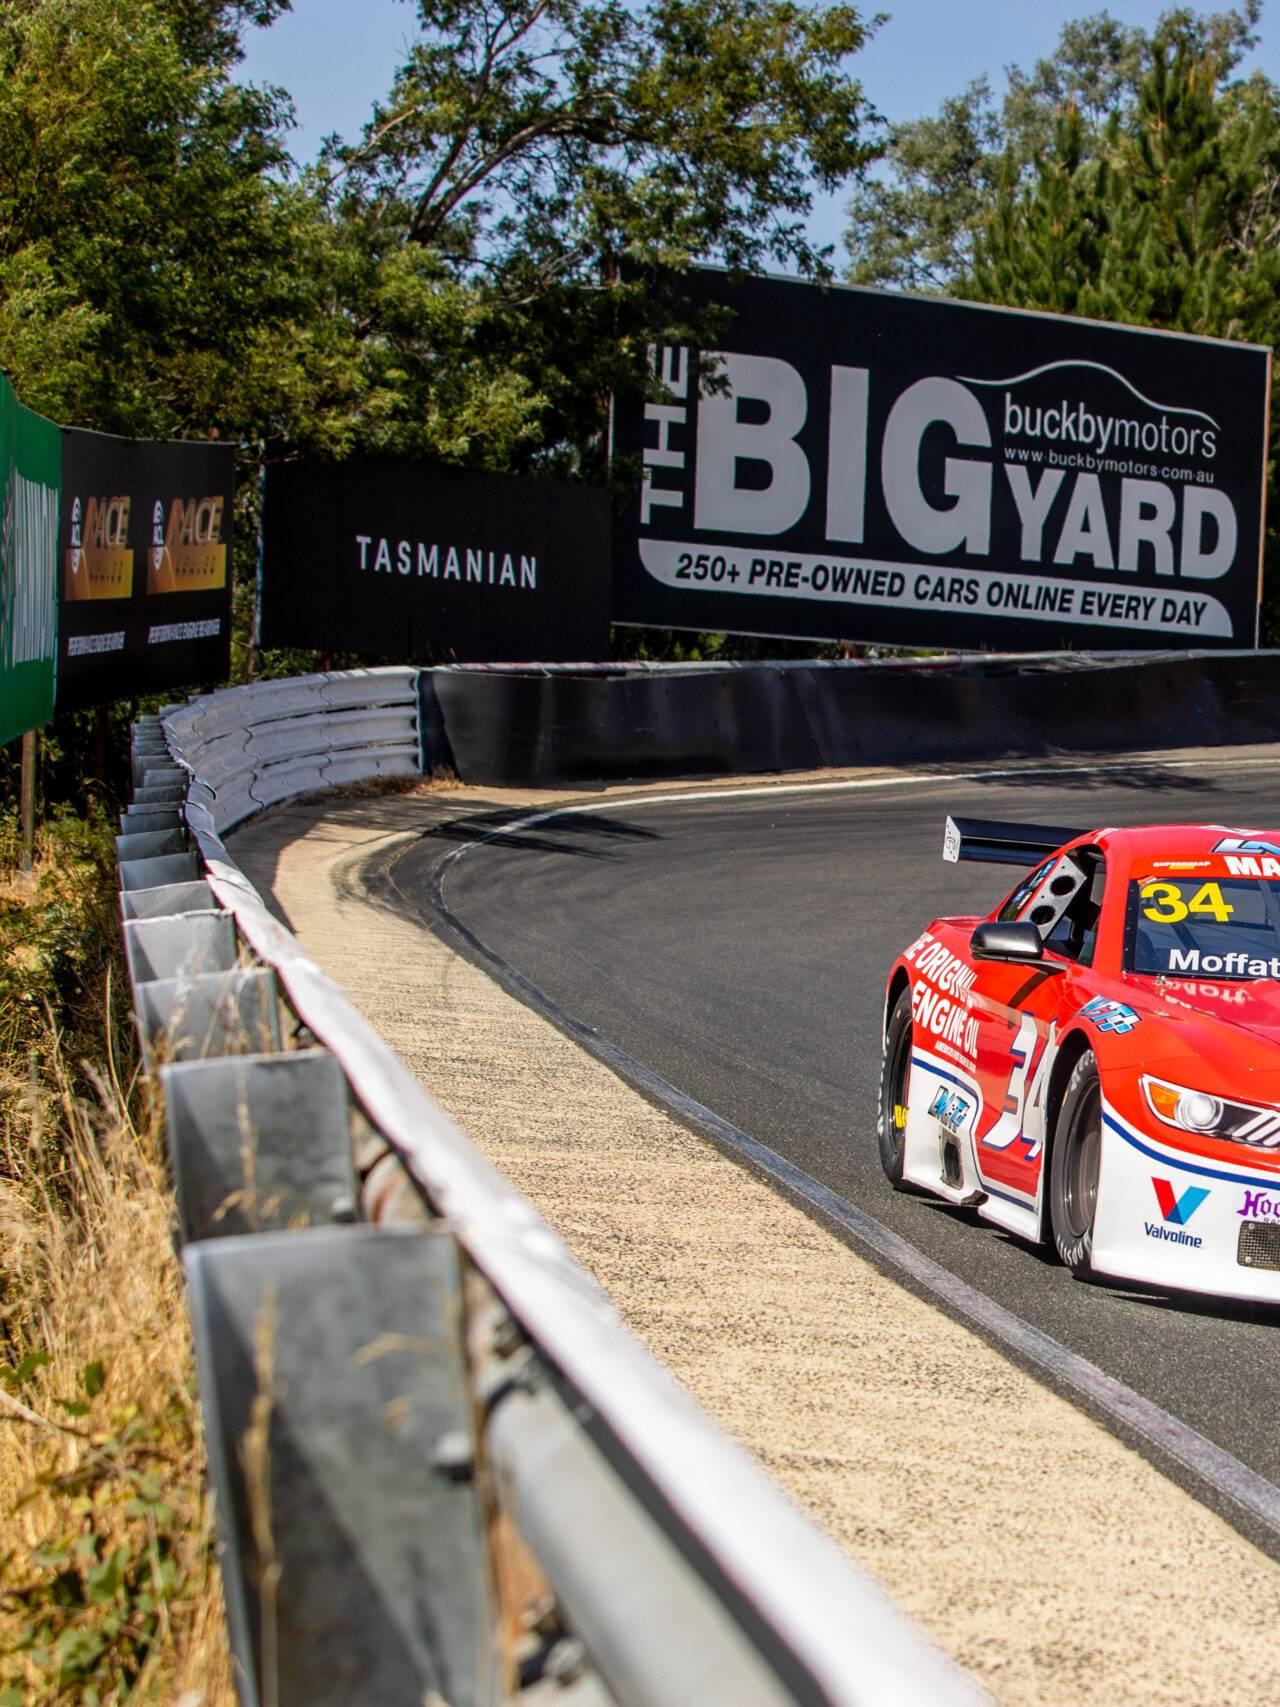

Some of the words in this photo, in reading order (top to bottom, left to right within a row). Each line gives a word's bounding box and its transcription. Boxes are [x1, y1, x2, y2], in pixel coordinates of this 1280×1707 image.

[640, 343, 690, 525] THE
[693, 350, 993, 555] BIG
[1004, 392, 1217, 459] buckbymotors
[1003, 462, 1238, 580] YARD
[355, 534, 537, 589] TASMANIAN
[675, 553, 740, 583] 250+
[748, 558, 906, 598] PRE-OWNED
[913, 574, 980, 606] CARS
[986, 581, 1075, 614] ONLINE
[1080, 590, 1157, 622] EVERY
[1160, 598, 1208, 627] DAY
[1140, 882, 1235, 924] 34
[911, 979, 967, 1048] ENGINE
[981, 1009, 1058, 1162] 34
[1144, 1221, 1203, 1248] Valvoline
